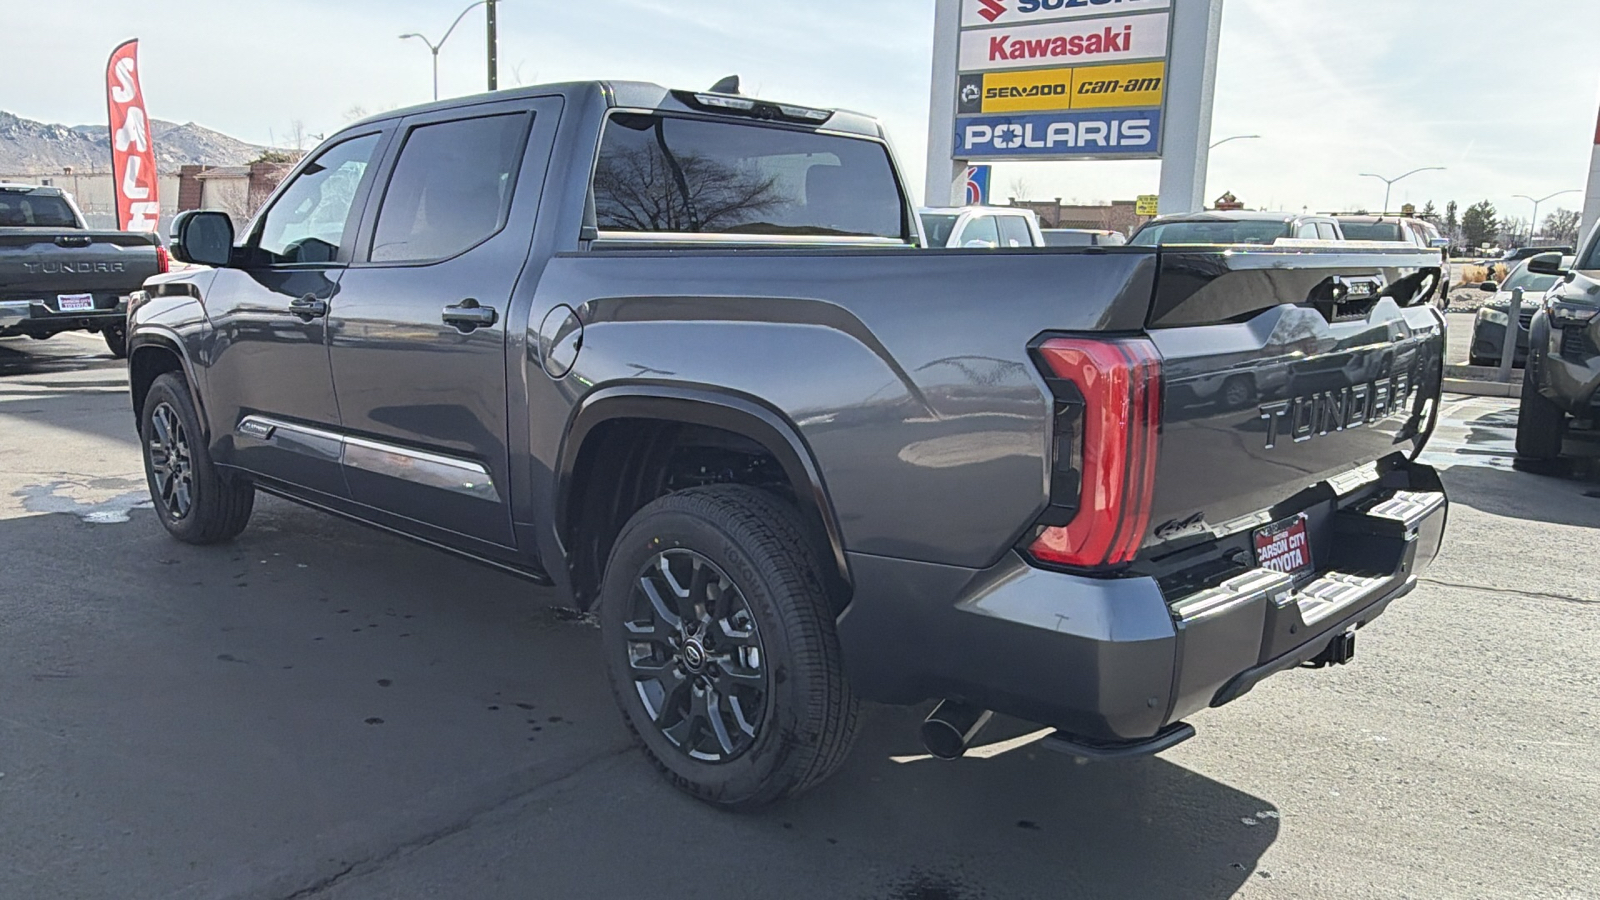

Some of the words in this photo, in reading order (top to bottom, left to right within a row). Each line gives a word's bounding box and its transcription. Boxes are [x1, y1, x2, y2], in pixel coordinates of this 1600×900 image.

[989, 25, 1132, 61] Kawasaki
[964, 119, 1151, 149] POLARIS
[23, 262, 125, 274] TUNDRA
[1258, 373, 1408, 450] TUNDRA
[1288, 531, 1305, 549] CITY
